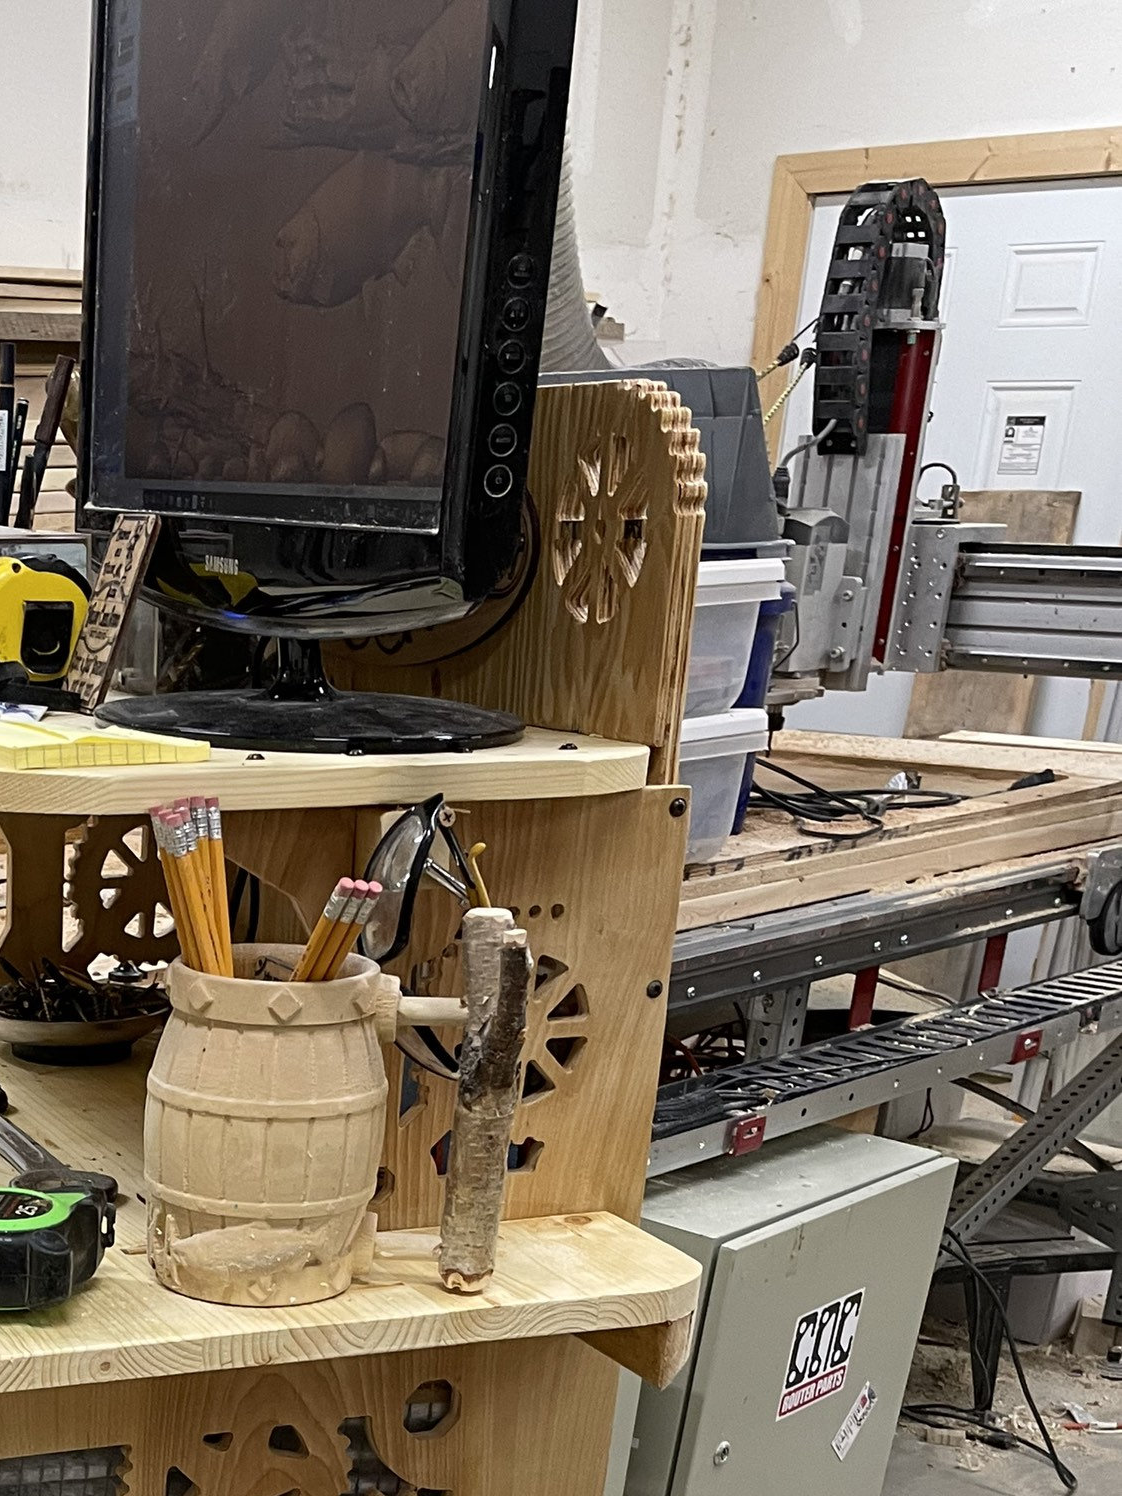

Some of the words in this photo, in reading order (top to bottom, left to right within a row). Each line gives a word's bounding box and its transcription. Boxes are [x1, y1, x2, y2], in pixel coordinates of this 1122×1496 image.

[205, 554, 239, 576] SAMSUNG
[15, 1204, 39, 1216] 25
[780, 1382, 816, 1414] ROUTER
[814, 1368, 845, 1398] PARTS
